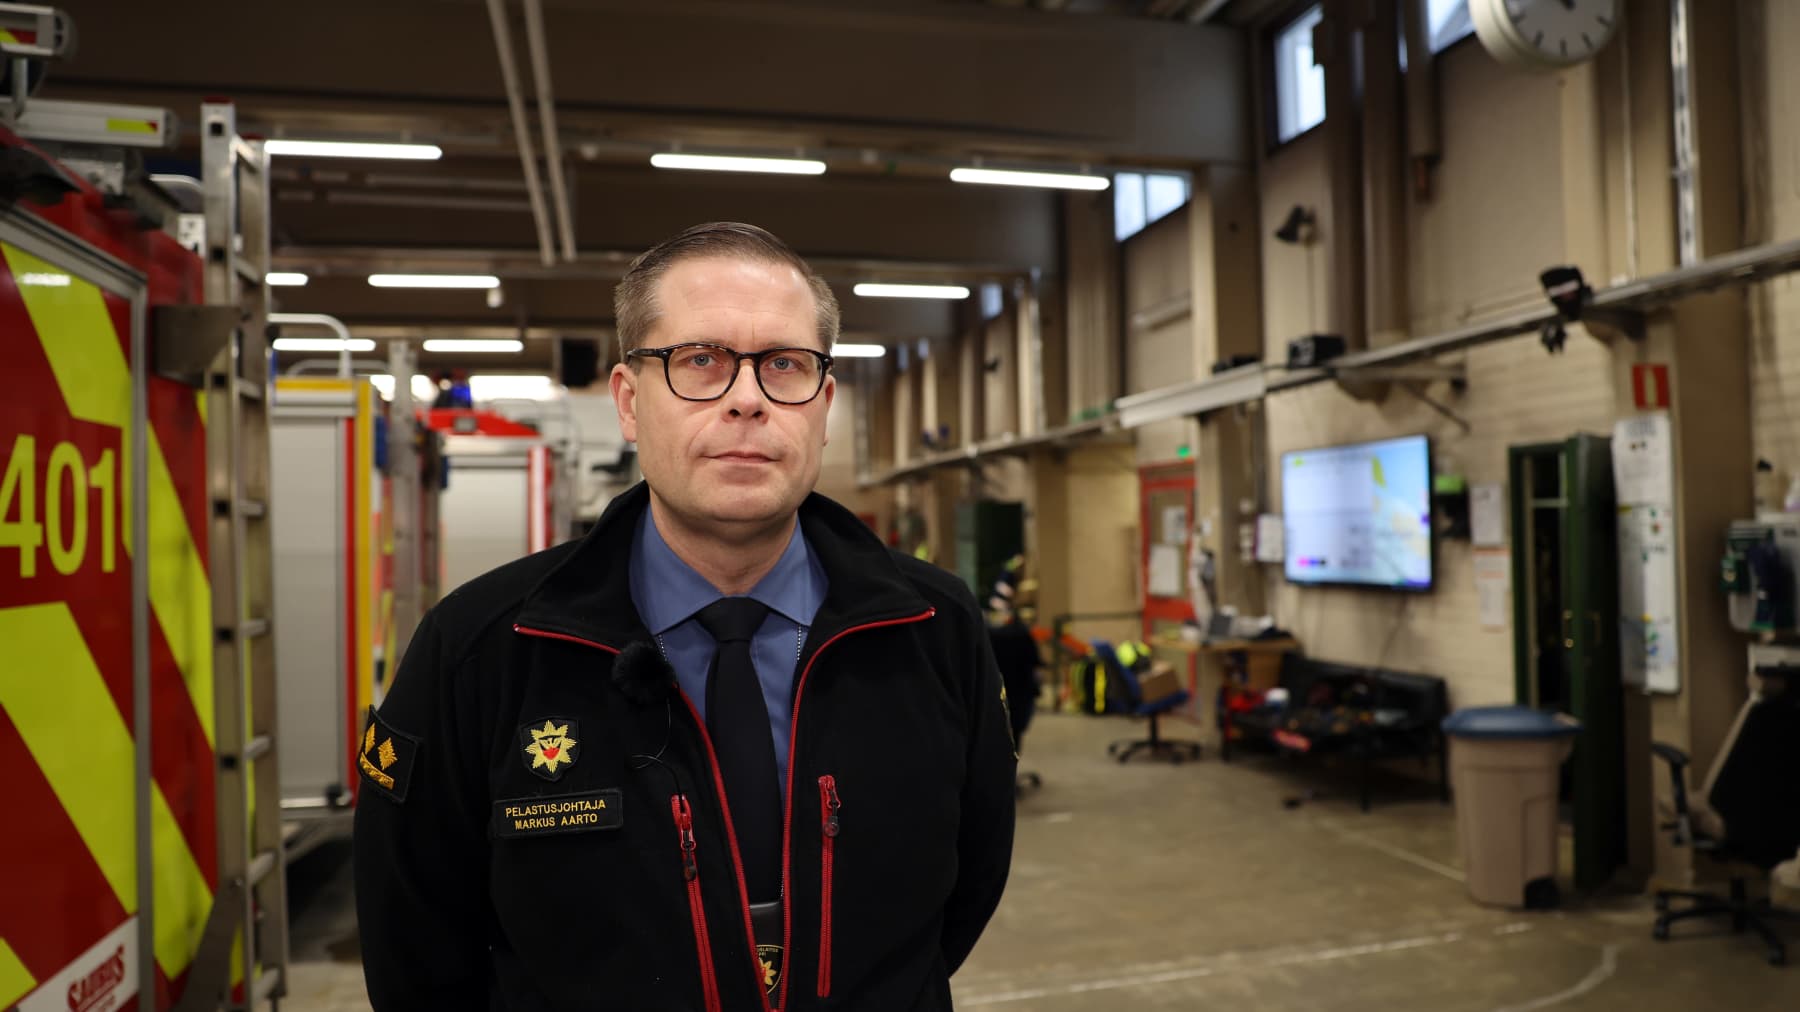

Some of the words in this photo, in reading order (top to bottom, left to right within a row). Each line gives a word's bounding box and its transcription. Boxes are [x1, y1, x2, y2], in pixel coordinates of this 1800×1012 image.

[0, 433, 116, 578] 401
[505, 799, 606, 817] PELASTUSJOHTAJA
[514, 816, 556, 830] MARKUS
[561, 813, 598, 826] AARTO
